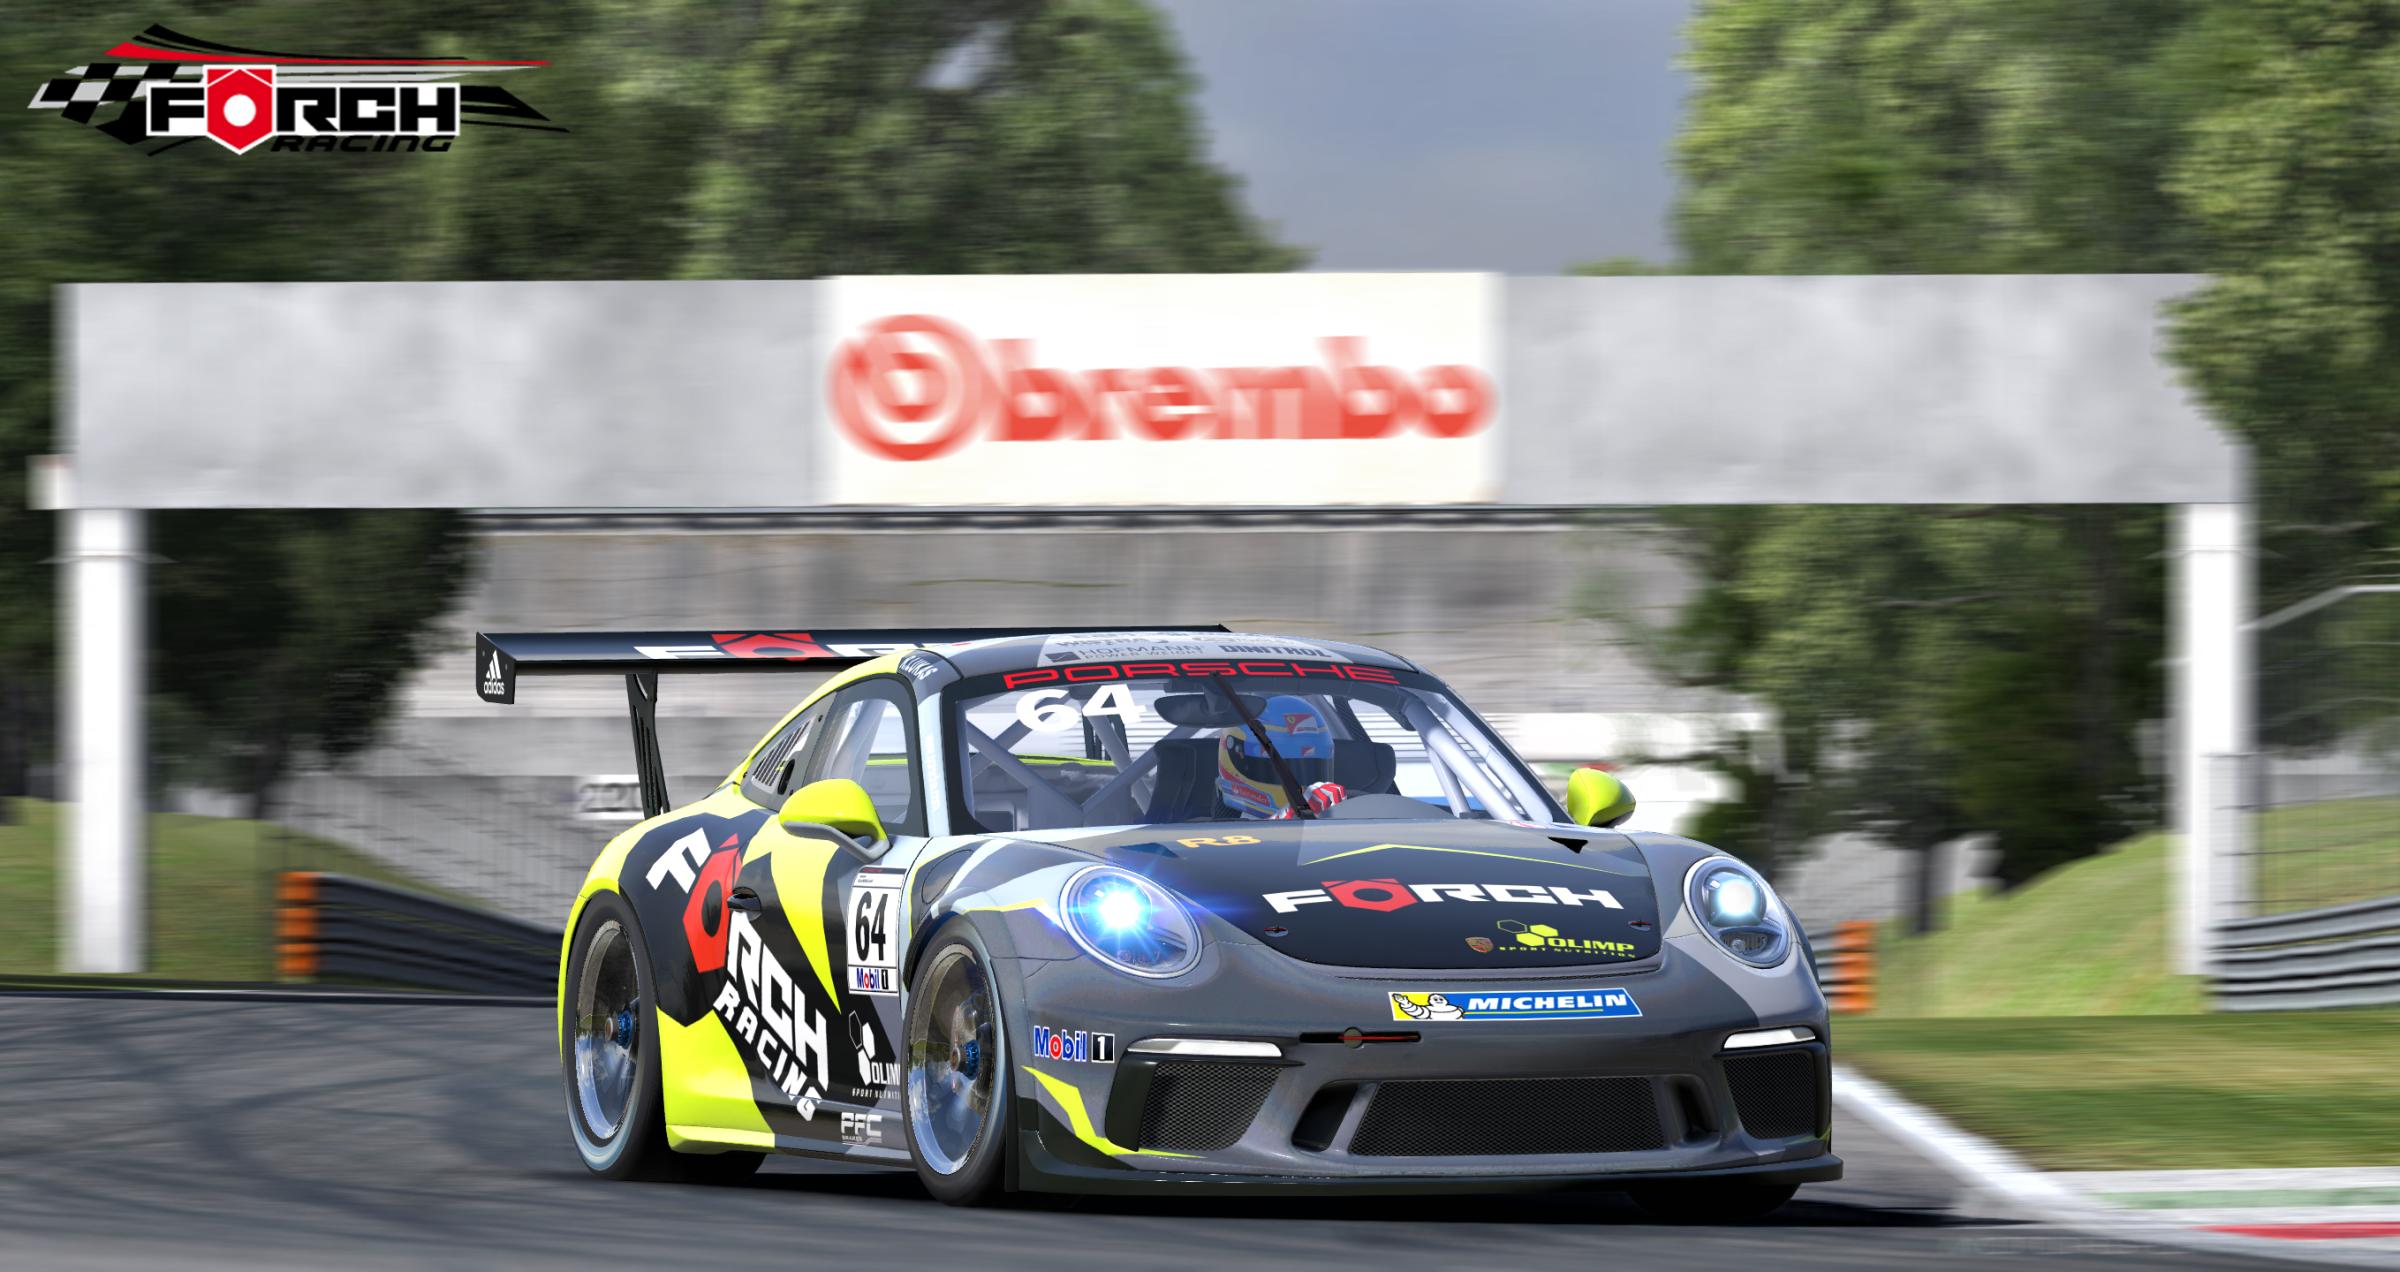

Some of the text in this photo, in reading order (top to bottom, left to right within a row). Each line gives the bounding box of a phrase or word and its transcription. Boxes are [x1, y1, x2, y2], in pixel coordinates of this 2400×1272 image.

[985, 336, 1499, 441] brembo
[1079, 645, 1201, 656] HOFMANN
[483, 679, 505, 695] adidas
[1003, 662, 1401, 689] PORSCHE
[1016, 684, 1147, 732] 64
[1262, 878, 1624, 912] FORCH
[855, 891, 888, 961] 64
[1547, 937, 1635, 952] OLIMP
[1554, 948, 1636, 958] NUTRITION
[856, 968, 880, 989] Mobil
[1467, 994, 1627, 1010] MICHELIN
[712, 980, 822, 1121] RACING
[1034, 1025, 1087, 1062] Mobil
[871, 1062, 900, 1085] OLIM
[841, 1112, 882, 1137] PFC
